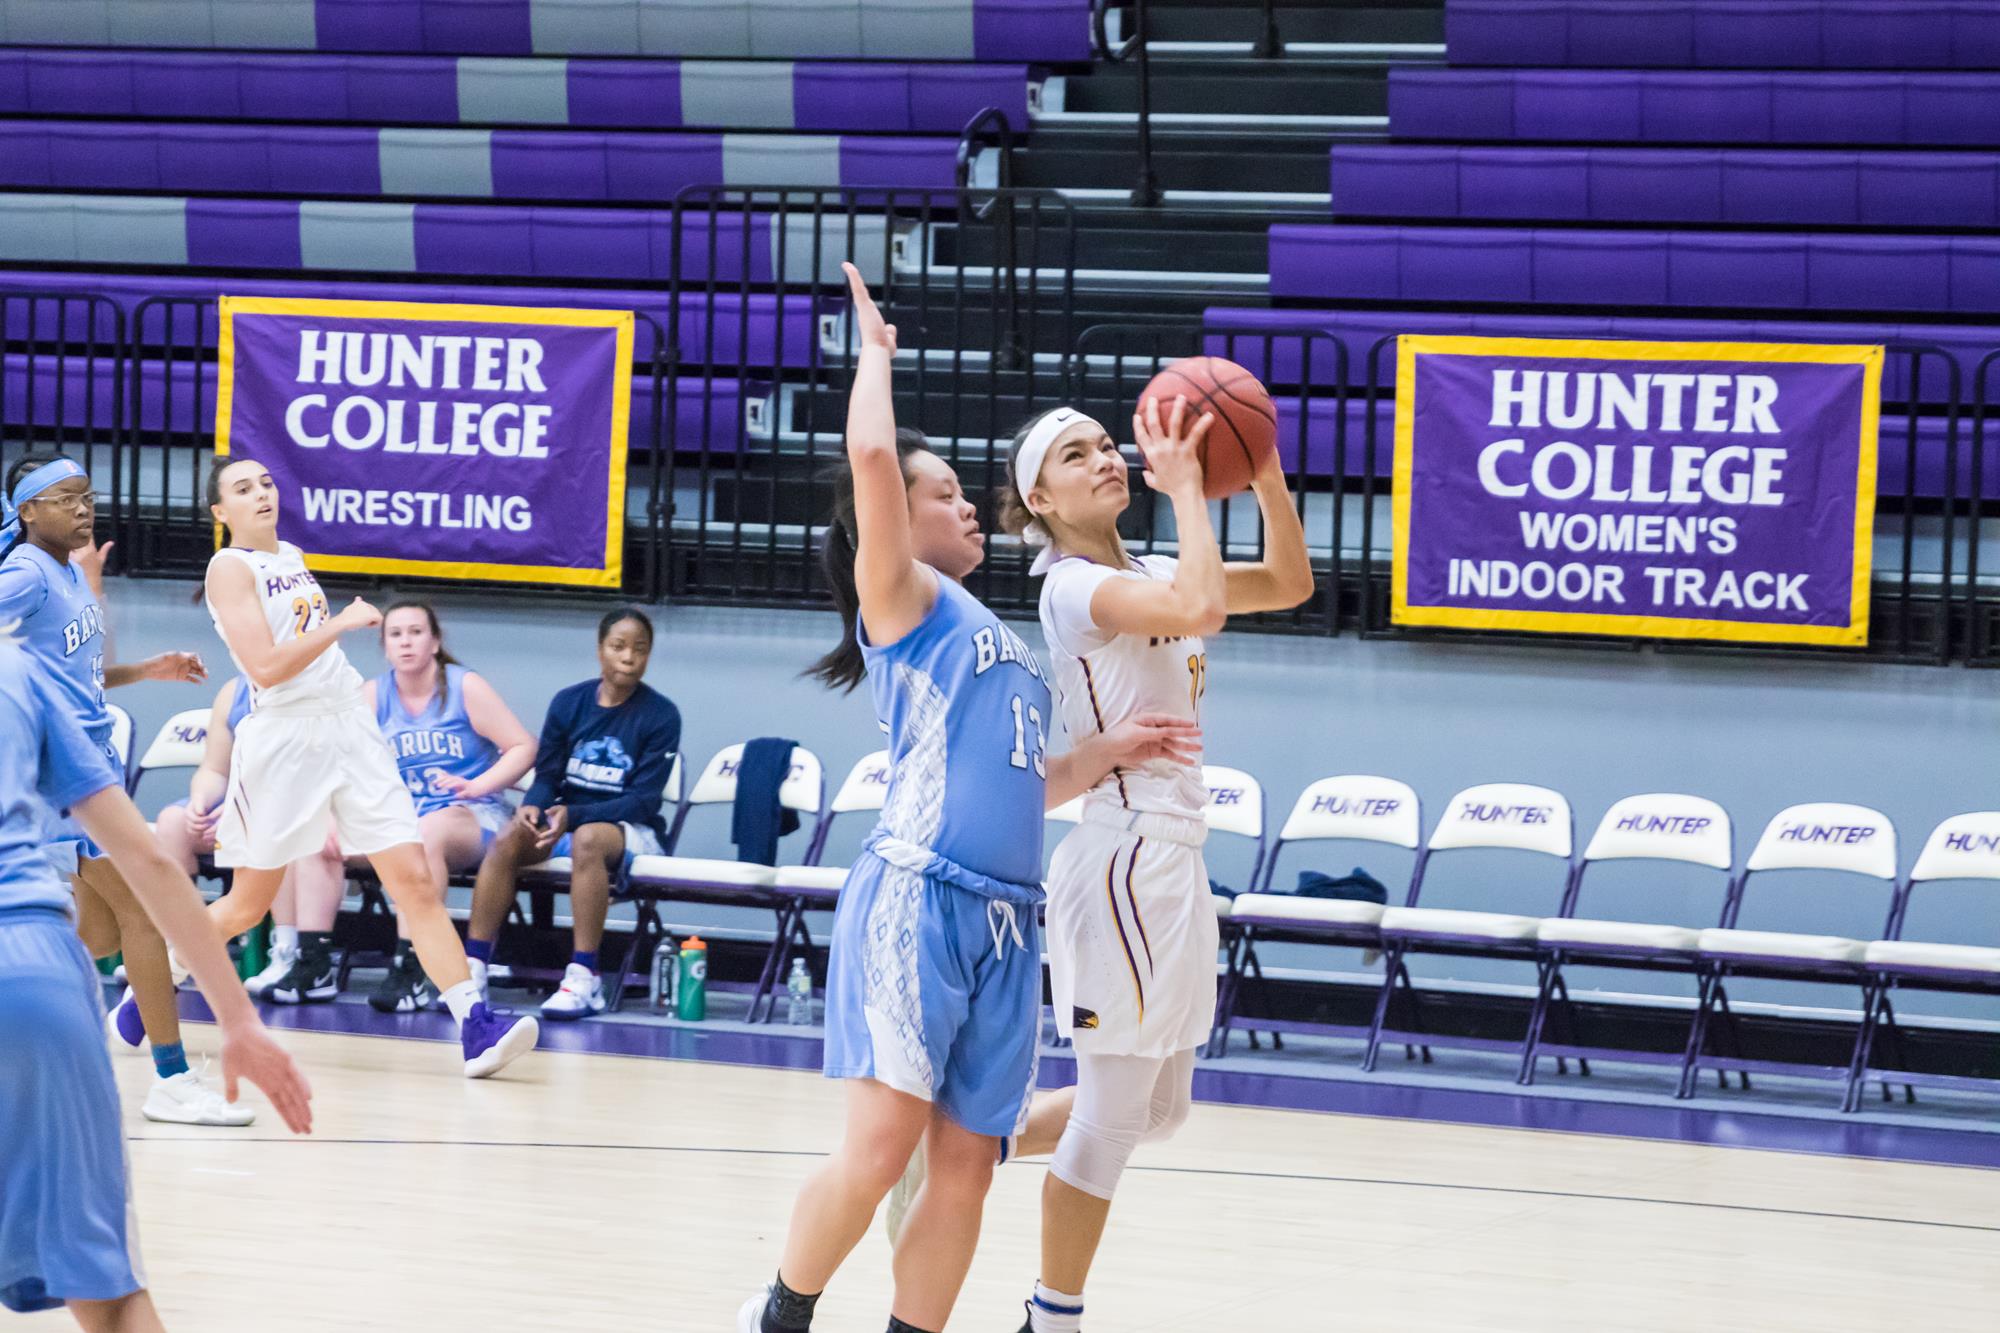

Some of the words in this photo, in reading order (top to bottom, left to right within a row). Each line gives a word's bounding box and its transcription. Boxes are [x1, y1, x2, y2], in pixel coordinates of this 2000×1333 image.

[296, 330, 548, 393] HUNTER
[285, 394, 552, 458] COLLEGE
[1488, 369, 1781, 434] HUNTER
[1477, 438, 1788, 506] COLLEGE
[302, 486, 532, 532] WRESTLING
[1519, 511, 1738, 555] WOMEN'S
[1448, 559, 1625, 604] INDOOR
[1644, 566, 1810, 611] TRACK
[972, 623, 1050, 692] BARU
[1010, 694, 1046, 780] 13
[1312, 795, 1400, 816] HUNTER
[1460, 803, 1553, 824] HUNTER
